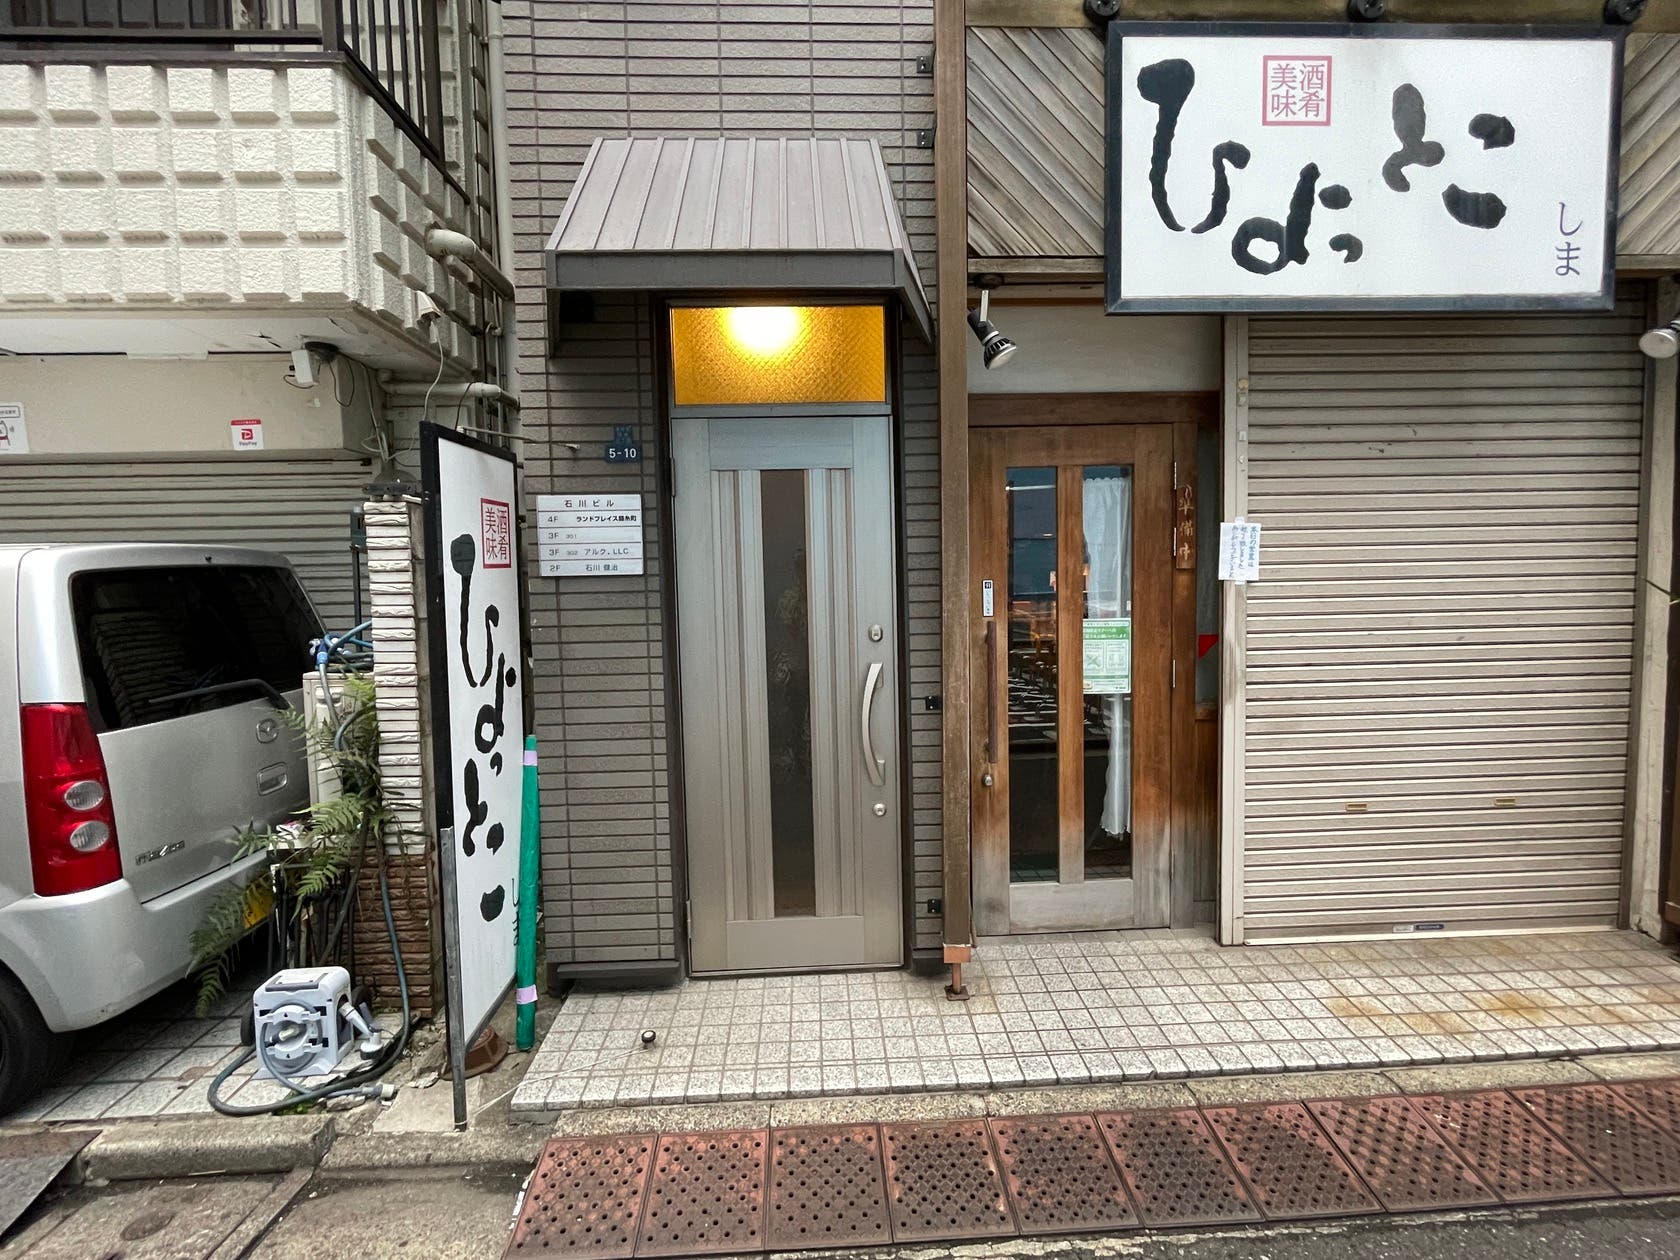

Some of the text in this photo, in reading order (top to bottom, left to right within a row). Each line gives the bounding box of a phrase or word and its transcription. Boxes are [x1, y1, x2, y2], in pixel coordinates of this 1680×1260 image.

[1137, 58, 1516, 275] ひょっとこ
[1554, 201, 1583, 276] しま
[609, 448, 637, 459] 5-10
[564, 499, 615, 508] 石川ビル
[547, 515, 559, 523] 4F
[548, 532, 559, 540] 3F
[550, 564, 561, 572] 2F
[450, 534, 517, 922] ひょっとこ
